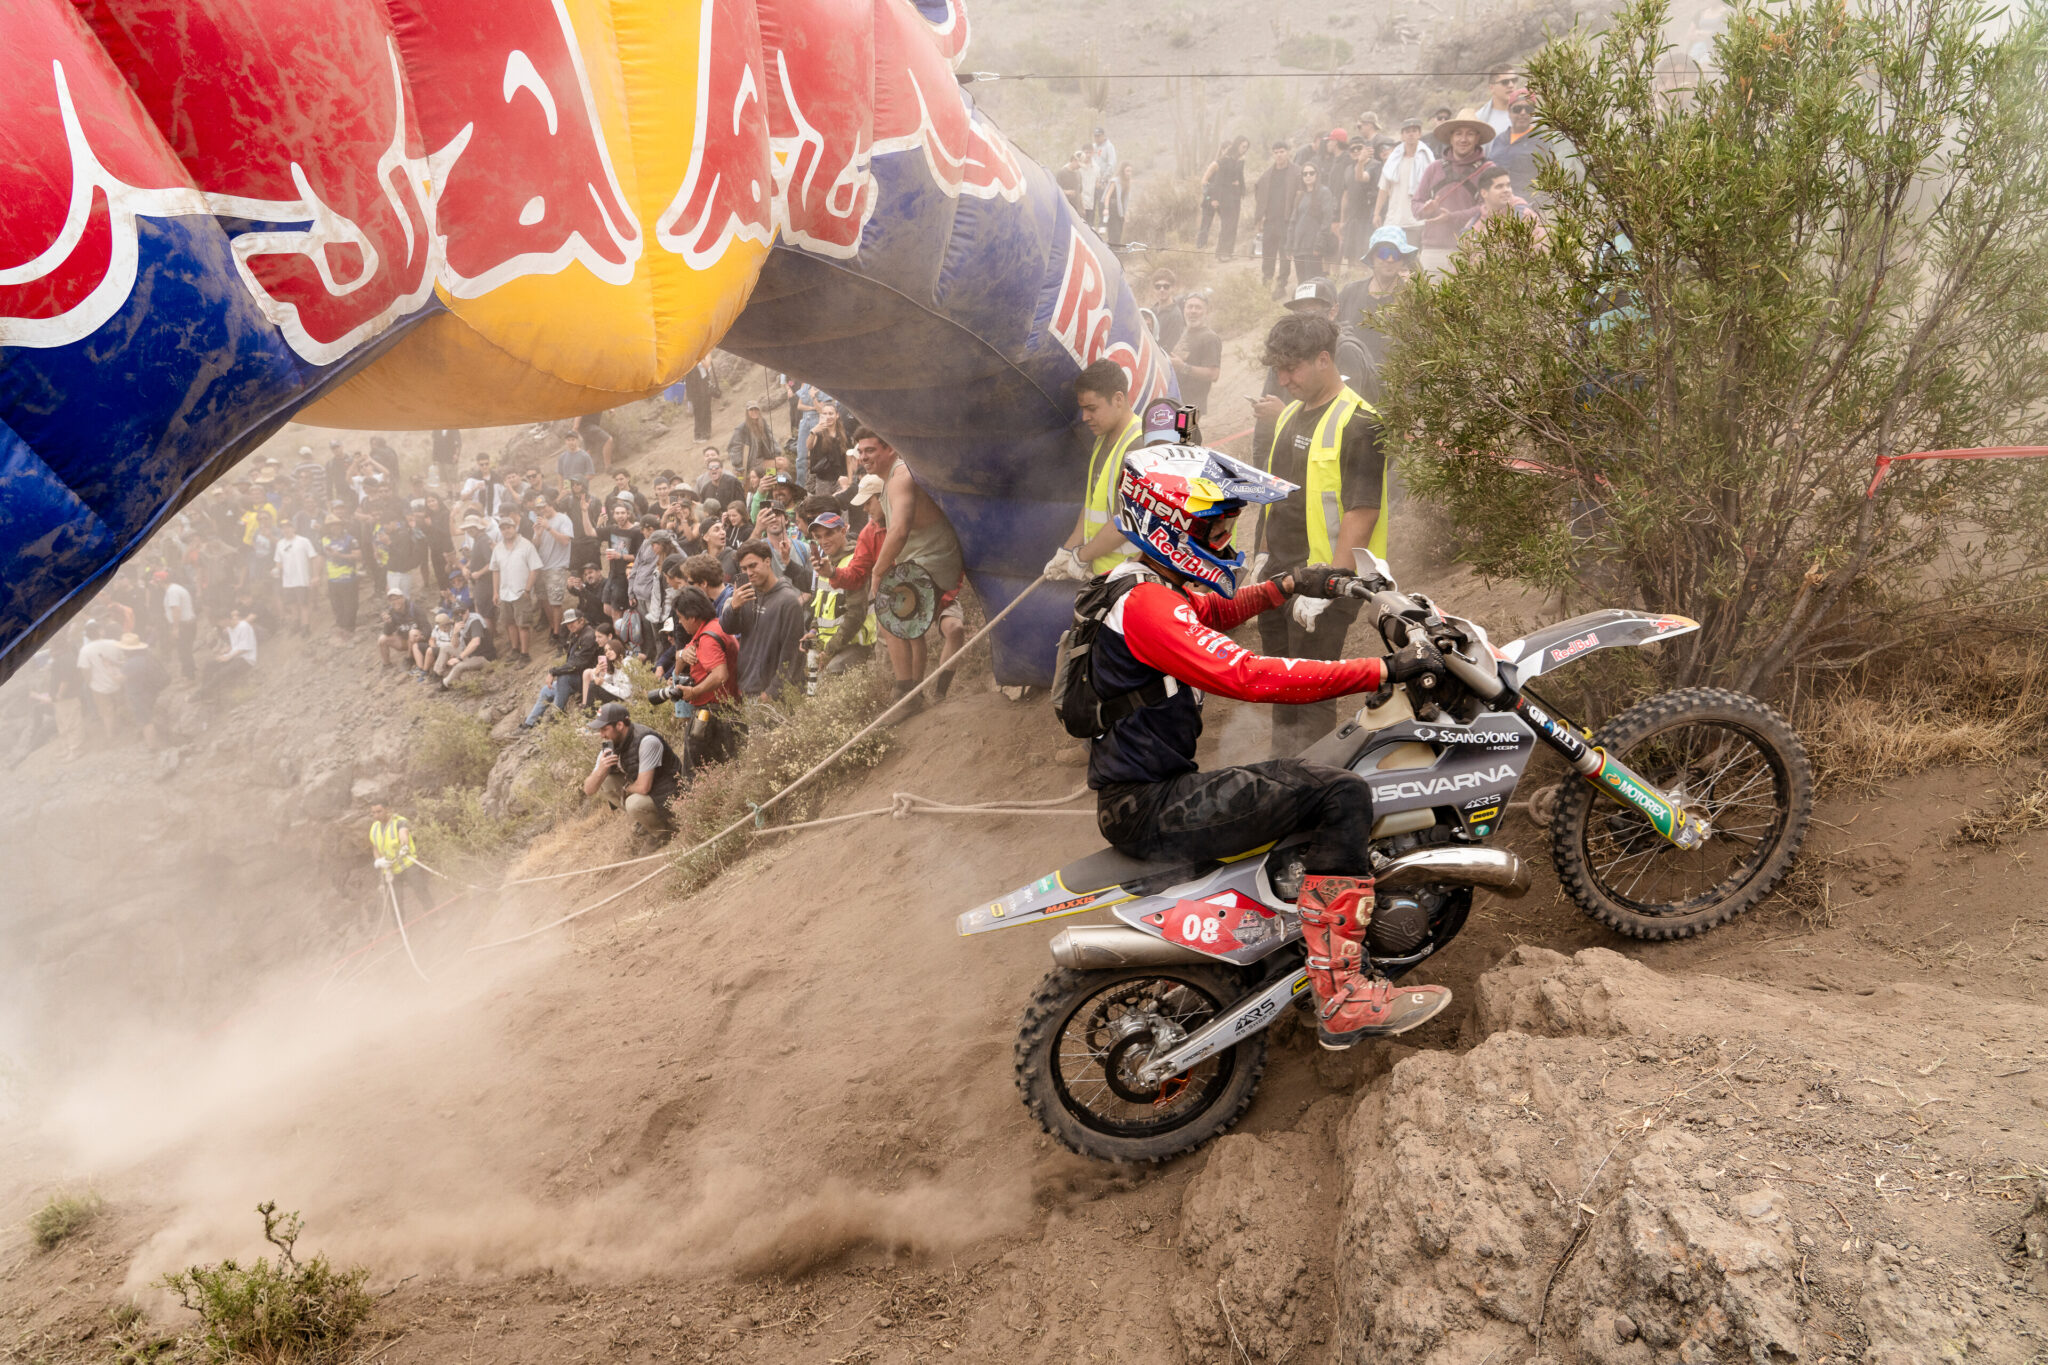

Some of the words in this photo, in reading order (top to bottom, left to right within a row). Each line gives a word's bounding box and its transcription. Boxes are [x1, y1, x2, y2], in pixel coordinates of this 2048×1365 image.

[1051, 228, 1152, 411] Red
[1148, 526, 1188, 565] Red
[1182, 555, 1224, 584] Bull
[1551, 640, 1577, 662] Red
[1574, 632, 1600, 651] Bull
[1618, 780, 1669, 820] MOTOREX
[1044, 895, 1097, 914] MAXXIS
[1182, 914, 1220, 944] 08
